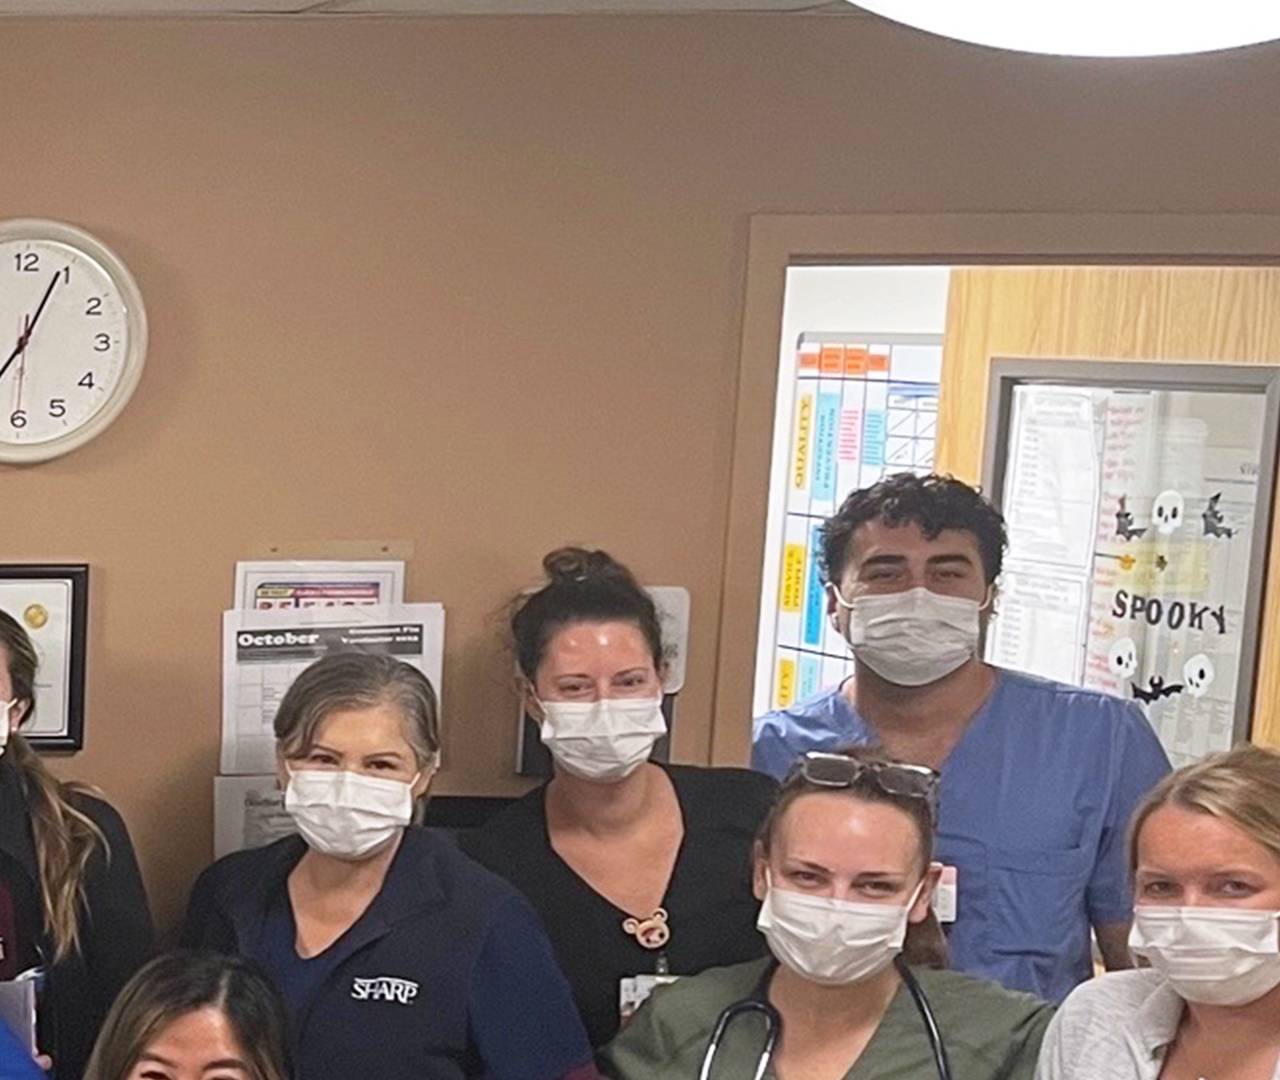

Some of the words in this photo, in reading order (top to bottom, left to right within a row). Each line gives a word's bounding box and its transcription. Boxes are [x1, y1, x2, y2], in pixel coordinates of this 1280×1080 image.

[14, 253, 40, 271] 12
[63, 266, 70, 284] 1
[85, 297, 102, 316] 2
[93, 333, 111, 352] 3
[77, 372, 95, 389] 4
[49, 399, 66, 418] 5
[10, 410, 27, 429] 6
[1111, 590, 1227, 634] SPOOKY
[238, 632, 320, 648] October
[351, 978, 419, 1004] SHARP
